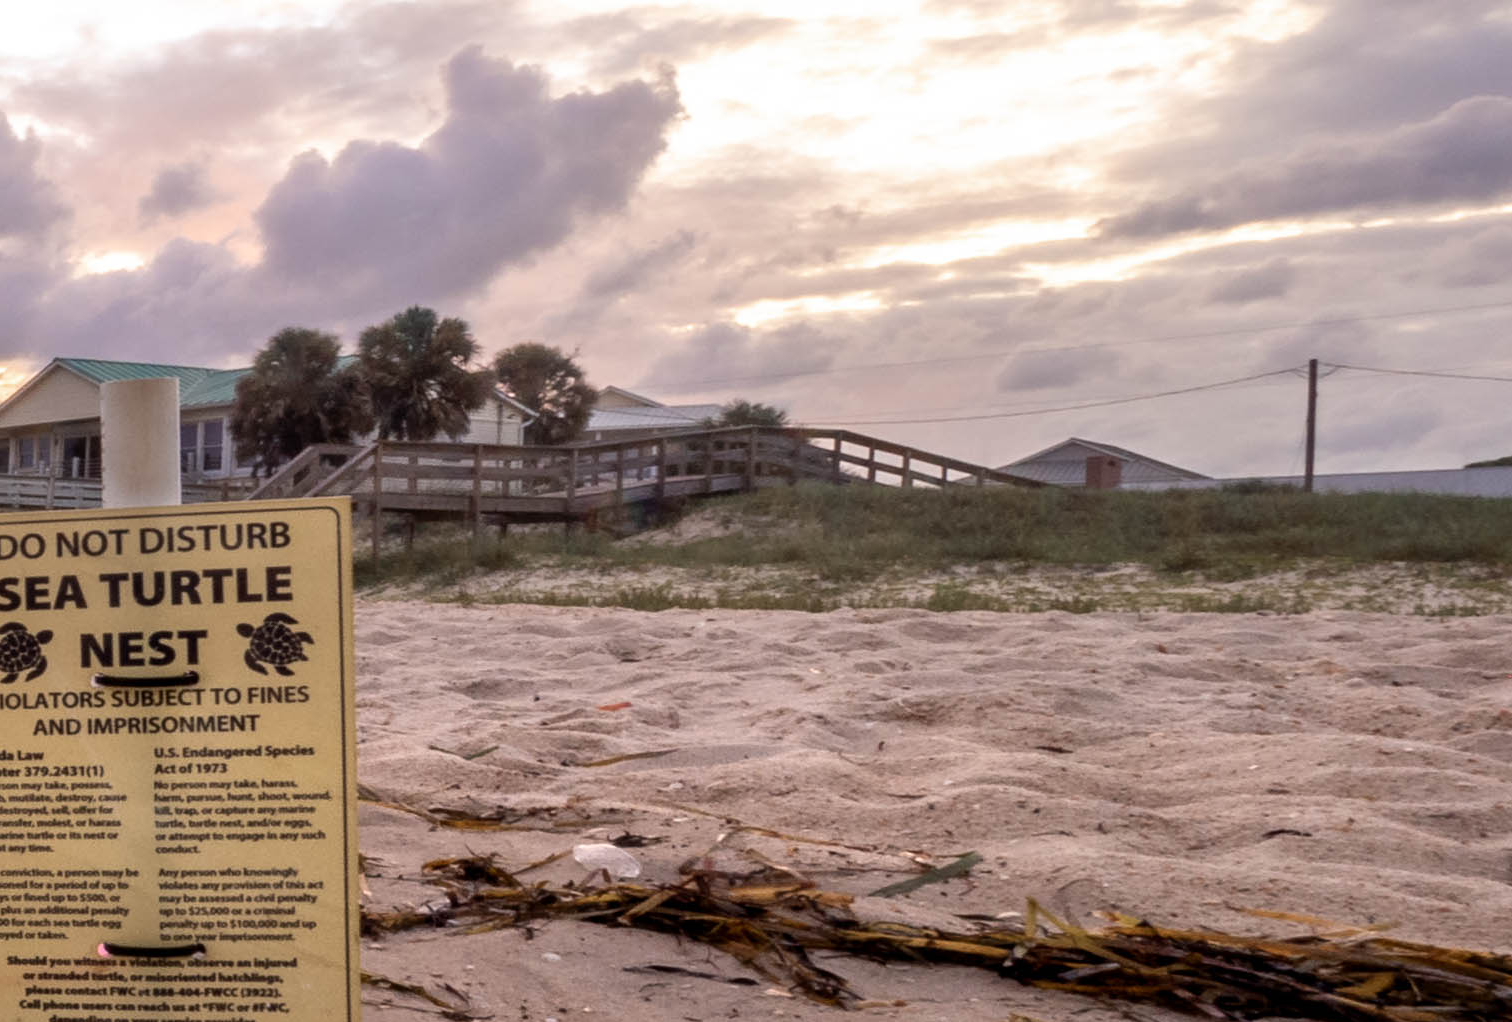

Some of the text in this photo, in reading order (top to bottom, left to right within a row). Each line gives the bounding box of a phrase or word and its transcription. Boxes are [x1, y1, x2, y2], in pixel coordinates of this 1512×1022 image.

[56, 529, 129, 558] NOT
[139, 521, 291, 554] DISTURB
[99, 565, 293, 608] TURTLE
[80, 629, 208, 668] NEST
[111, 686, 206, 707] SUBJECT
[210, 687, 242, 705] TO
[247, 685, 309, 704] FINES
[33, 714, 260, 736] AND IMPRISONMENT
[17, 750, 44, 761] Law
[153, 744, 315, 759] U.S. Endangered Species
[24, 765, 104, 778] 379.2431(1)
[154, 762, 227, 774] Act of 1973
[6, 957, 48, 966] Should
[48, 958, 71, 968] you
[73, 957, 117, 966] witness
[119, 959, 127, 967] a
[187, 958, 234, 967] observe
[255, 958, 297, 968] injured
[22, 971, 283, 984] or stranded turtle, or misoriented hatchlings,
[25, 985, 63, 996] please
[64, 987, 108, 996] contact
[109, 986, 136, 996] FWC
[240, 987, 282, 998] (3922).
[19, 999, 41, 1009] Cell
[42, 1000, 80, 1012] phone
[81, 1003, 113, 1011] users
[114, 1003, 136, 1011] can
[137, 1002, 170, 1012] reach
[172, 1004, 186, 1012] us
[187, 1003, 200, 1012] at
[236, 1004, 250, 1012] or
